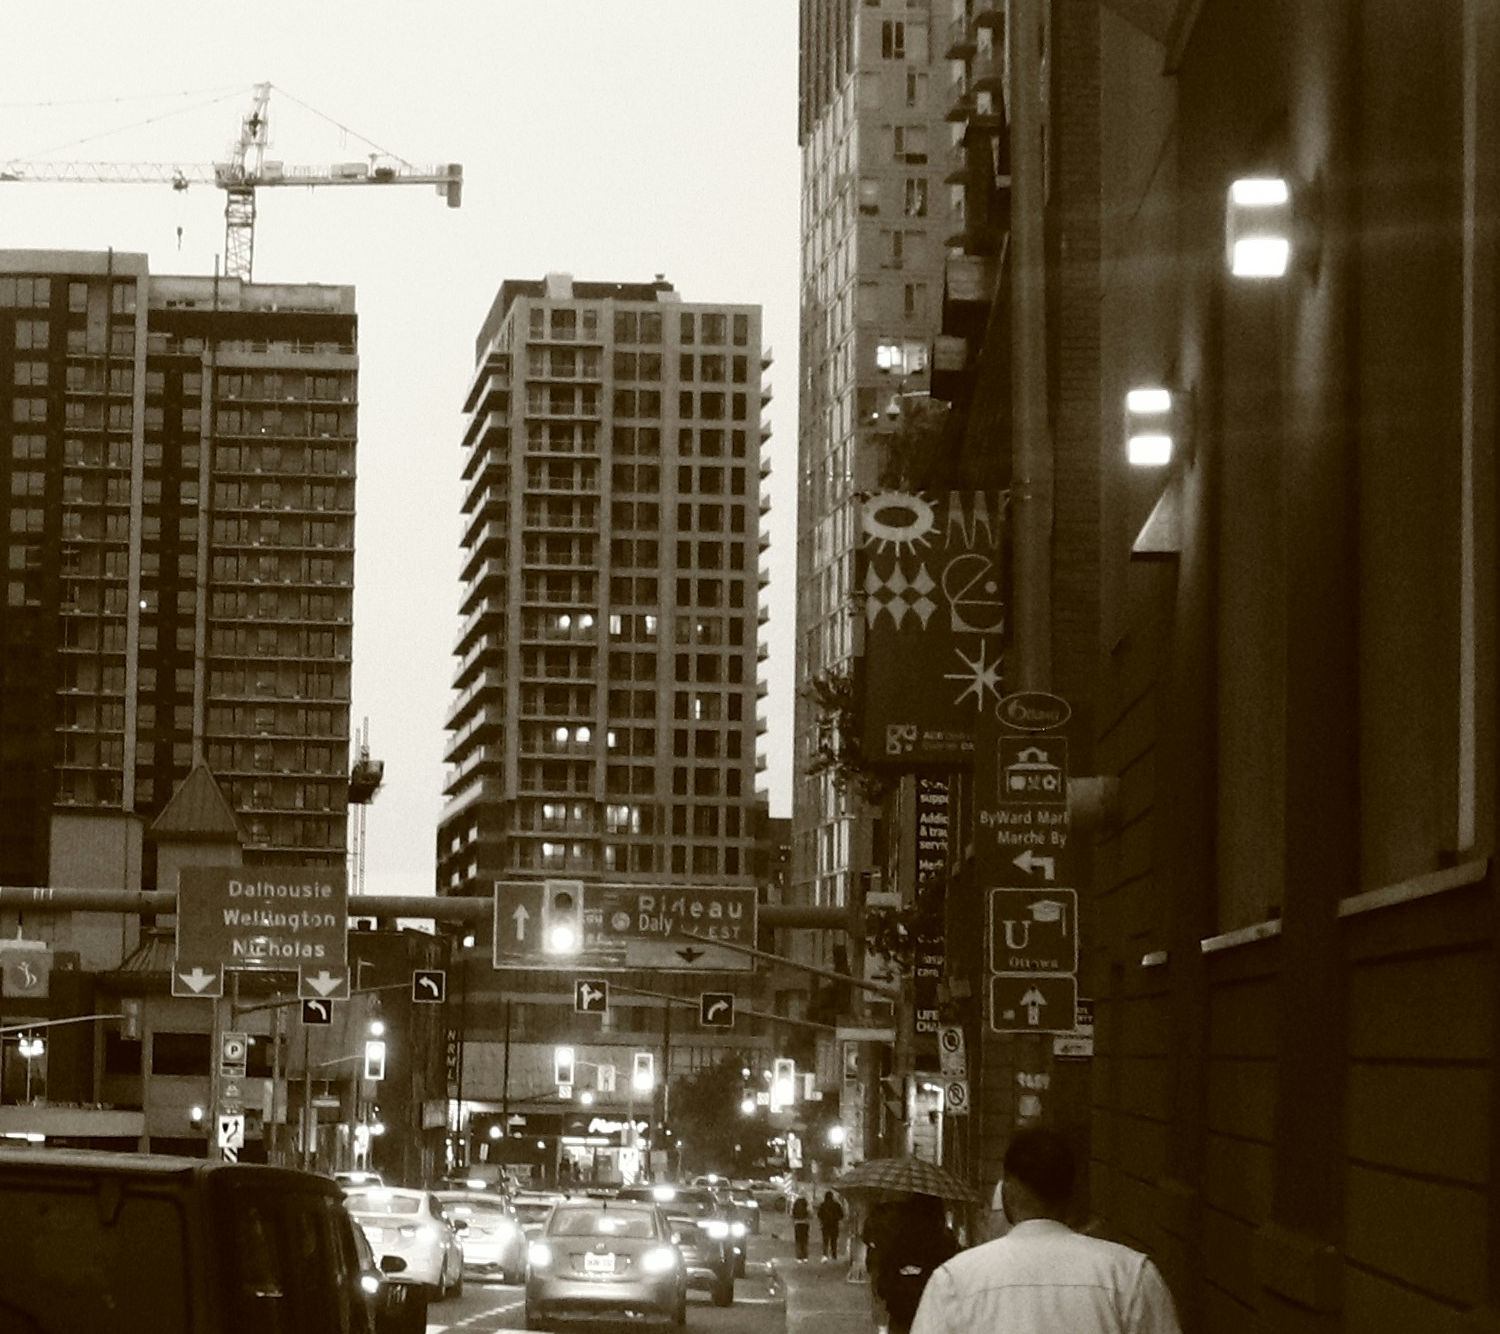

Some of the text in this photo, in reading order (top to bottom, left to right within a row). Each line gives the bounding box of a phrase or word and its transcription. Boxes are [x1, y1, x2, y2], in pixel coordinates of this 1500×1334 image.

[979, 810, 1032, 829] ByWard
[228, 879, 332, 898] Dalhousie
[638, 894, 743, 919] Rideau
[223, 907, 336, 933] Wellington
[638, 913, 673, 937] Daly
[1002, 919, 1033, 950] U
[232, 937, 326, 957] Nicholas
